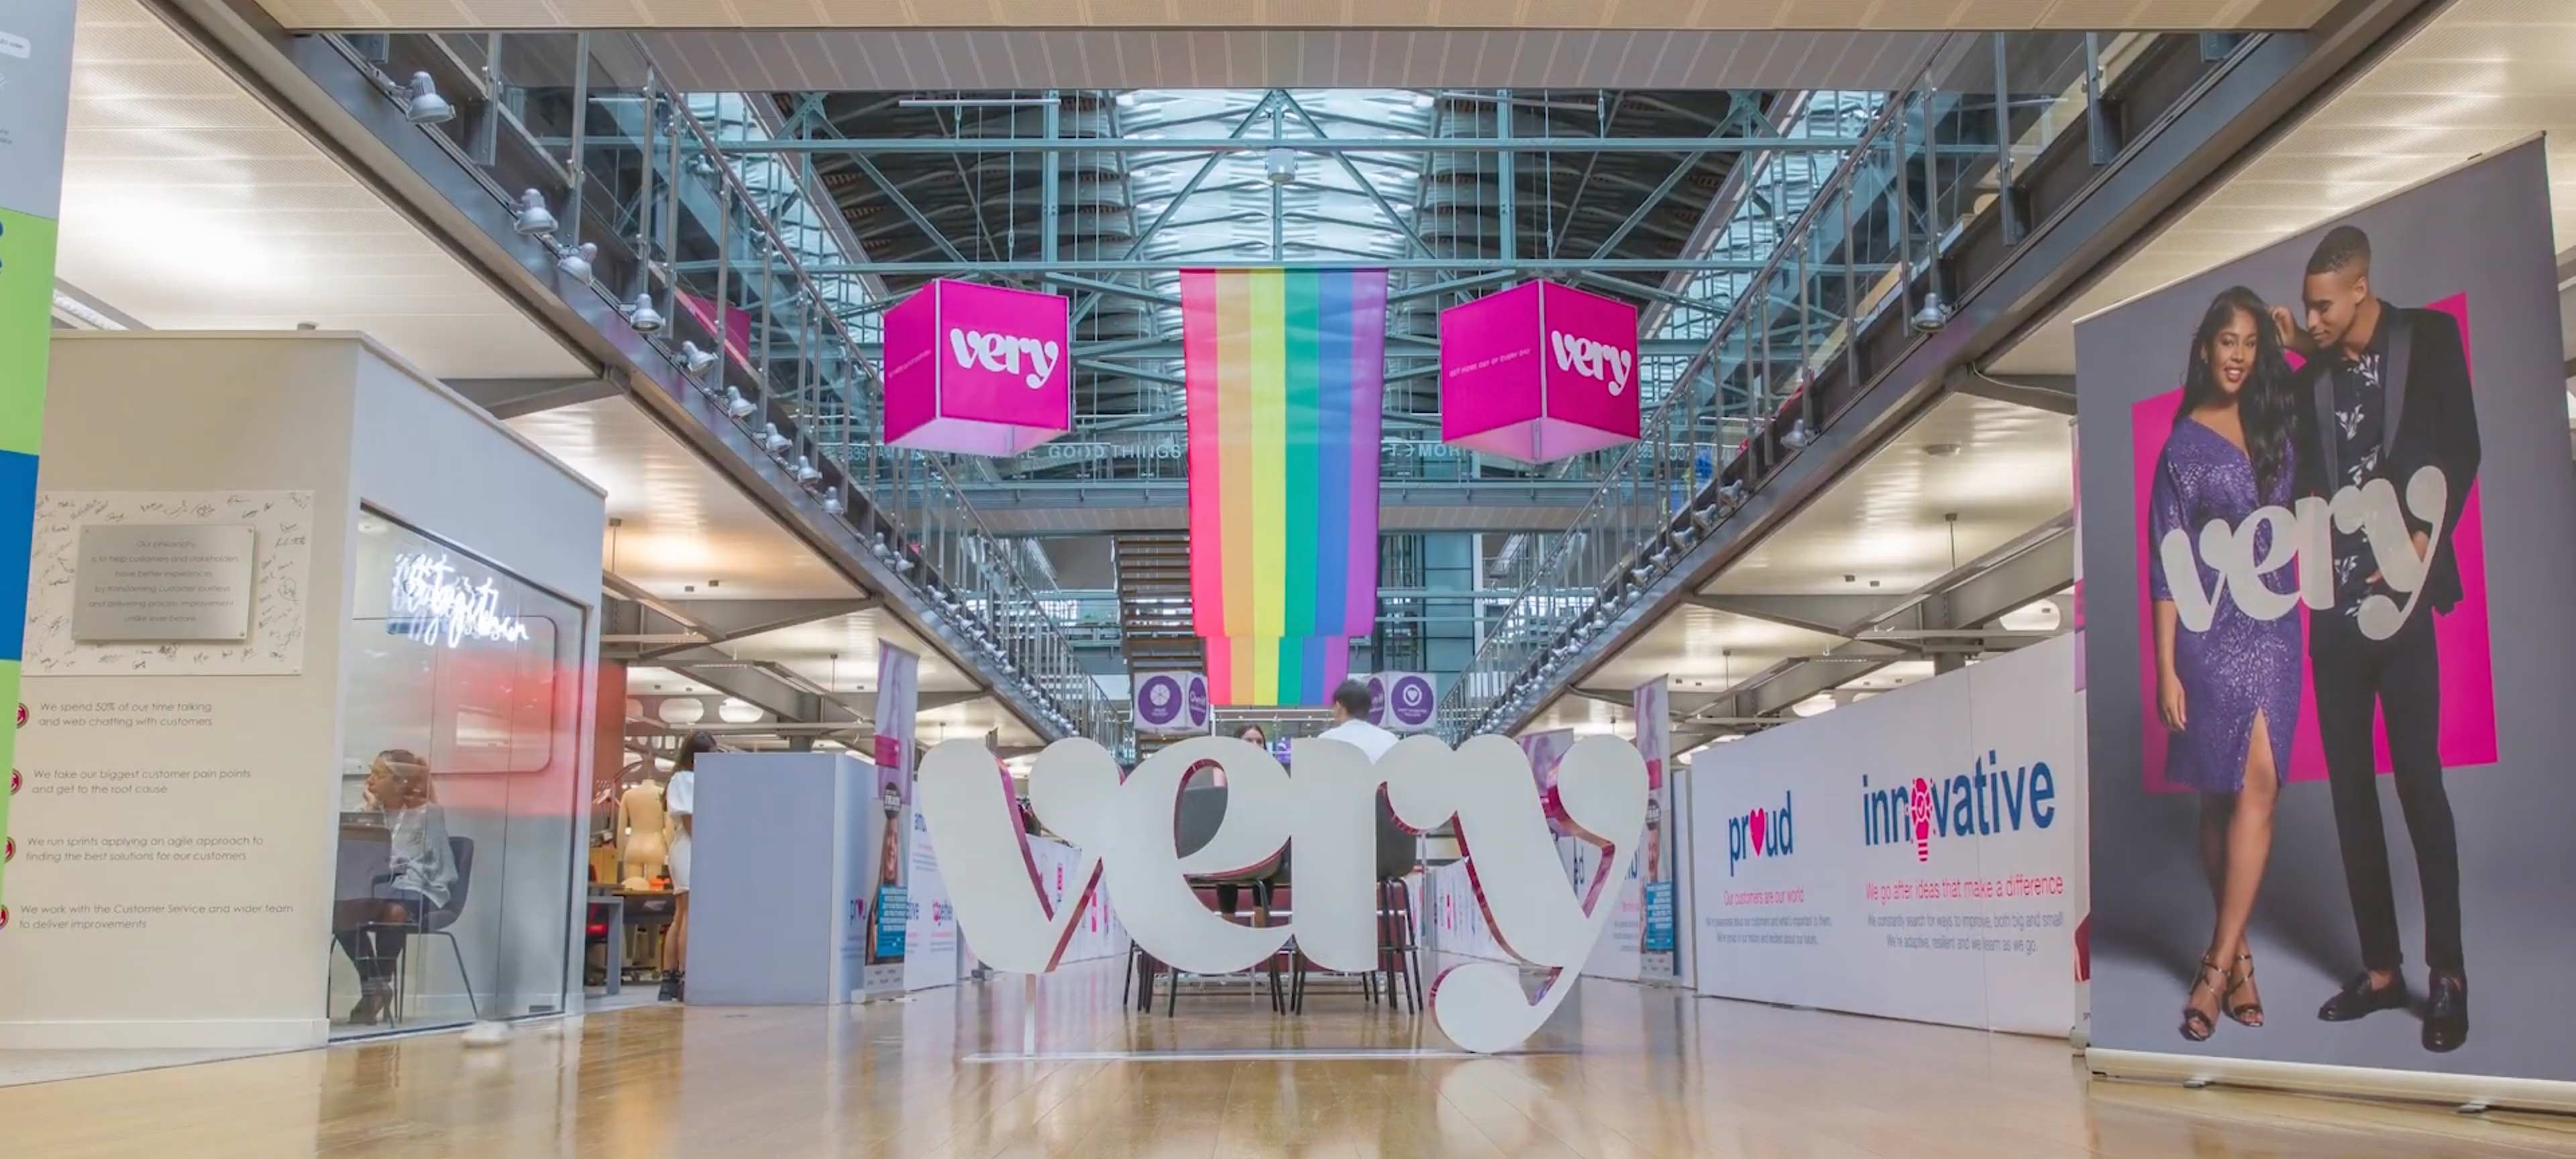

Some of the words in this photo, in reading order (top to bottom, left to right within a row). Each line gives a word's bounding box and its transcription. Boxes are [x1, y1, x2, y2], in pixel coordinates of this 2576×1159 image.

[949, 328, 1059, 389] very
[1551, 329, 1631, 396] very
[1049, 445, 1105, 459] GOOD
[1110, 445, 1182, 459] THINGS
[2160, 465, 2447, 641] very
[40, 702, 57, 712] We
[60, 702, 93, 715] spend
[95, 702, 115, 712] 50%
[118, 702, 129, 712] of
[131, 704, 149, 712] our
[152, 702, 174, 712] time
[177, 702, 212, 715] talking
[38, 717, 60, 727] and
[62, 717, 86, 727] web
[89, 717, 133, 730] chatting
[136, 717, 157, 727] with
[160, 717, 213, 727] customers
[34, 770, 51, 779] We
[54, 770, 77, 779] take
[100, 770, 139, 781] biggest
[142, 770, 190, 779] customer
[193, 770, 217, 781] pain
[219, 769, 252, 781] points
[32, 785, 54, 794] and
[57, 785, 74, 797] get
[78, 785, 88, 794] to
[91, 785, 108, 794] the
[111, 785, 132, 794] root
[28, 837, 45, 846] We
[66, 837, 99, 848] sprints
[101, 837, 148, 848] applying
[167, 837, 193, 848] agile
[196, 837, 250, 848] approach
[253, 837, 264, 846] to
[25, 852, 61, 863] finding
[64, 852, 81, 861] the
[84, 852, 107, 861] best
[109, 852, 154, 861] solutions
[156, 852, 170, 861] for
[193, 852, 247, 861] customers
[916, 734, 1648, 1054] very
[1866, 880, 1878, 899] We
[1880, 885, 1890, 905] go
[1893, 881, 1913, 899] after
[1915, 879, 1940, 899] ideas
[1942, 877, 1962, 898] that
[1964, 878, 1993, 897] make
[1996, 880, 2002, 897] a
[2006, 873, 2063, 897] difference
[21, 905, 38, 914] We
[41, 905, 66, 914] work
[69, 905, 91, 914] with
[93, 905, 111, 914] the
[113, 905, 166, 914] Customer
[168, 905, 205, 914] Service
[209, 905, 230, 914] and
[233, 905, 262, 914] wider
[265, 905, 294, 914] team
[19, 920, 30, 928] to
[33, 920, 68, 928] deliver
[71, 920, 148, 931] improvements
